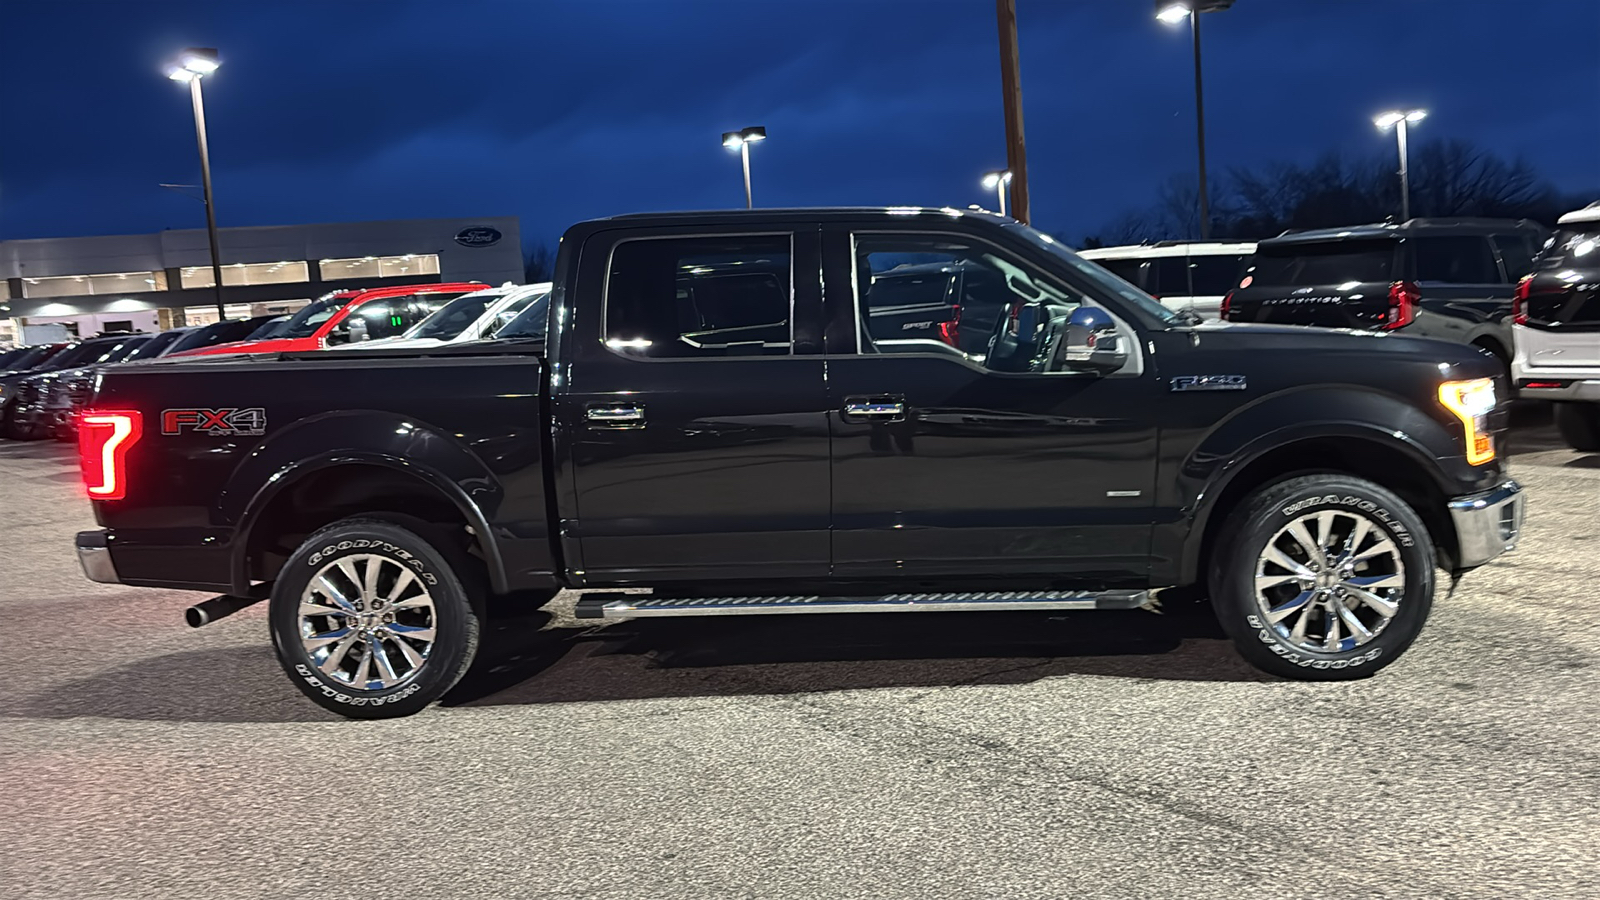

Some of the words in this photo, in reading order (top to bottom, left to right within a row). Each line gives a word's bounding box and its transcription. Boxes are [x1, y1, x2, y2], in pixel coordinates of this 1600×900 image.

[1262, 296, 1341, 305] EXPEDITION
[161, 407, 266, 435] FX4
[1282, 495, 1414, 547] WRANGLER
[308, 540, 438, 586] GOODYEAR
[1247, 615, 1383, 669] GOODYEAR
[296, 664, 421, 706] WRANGLER
